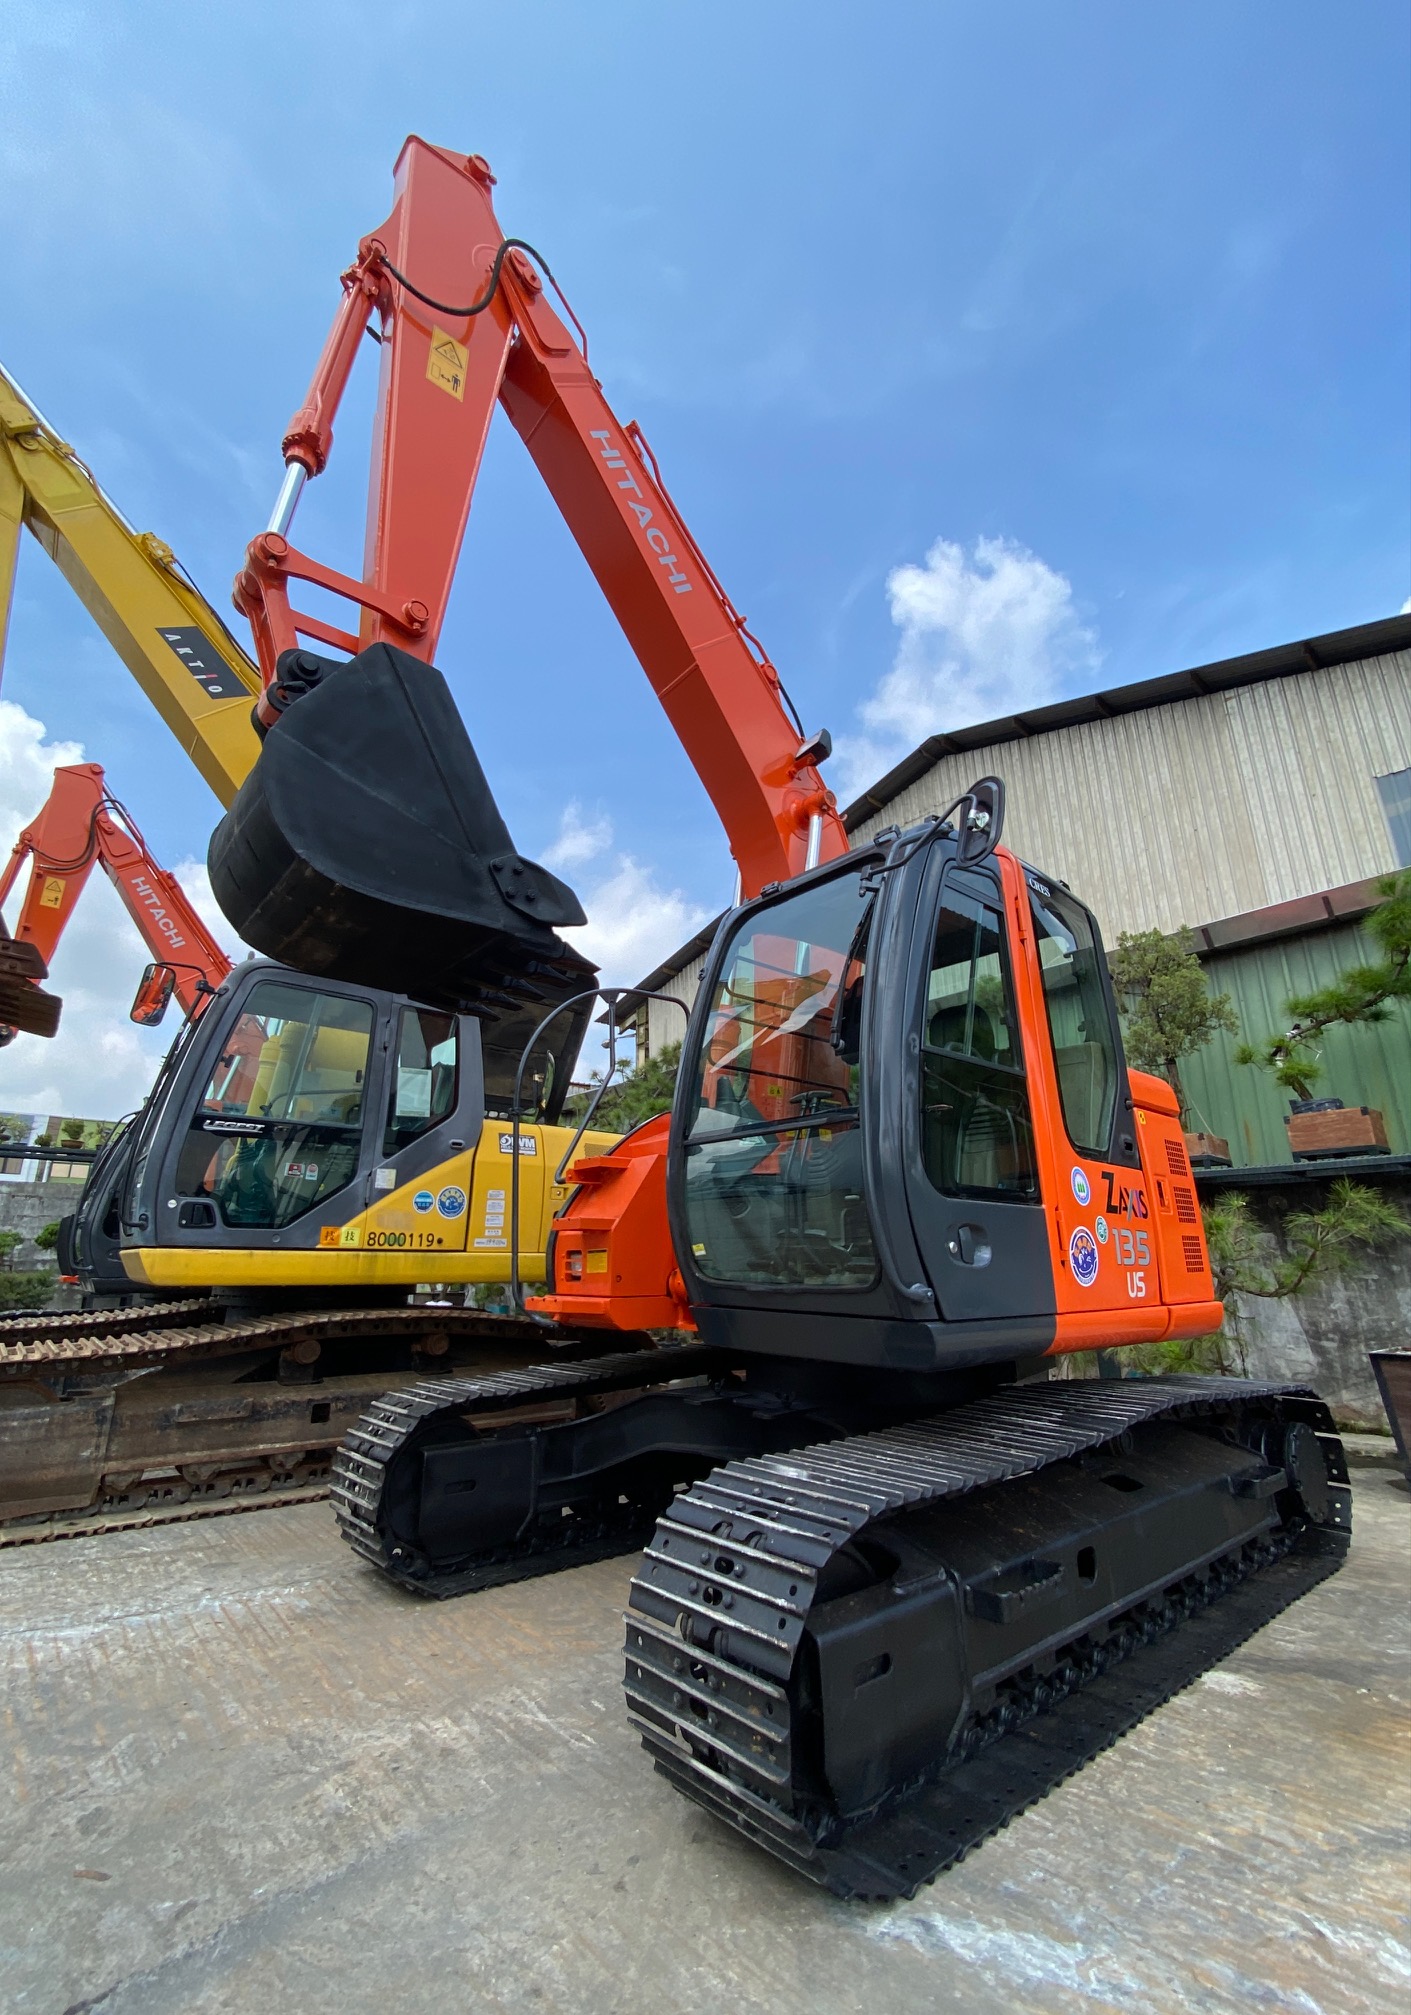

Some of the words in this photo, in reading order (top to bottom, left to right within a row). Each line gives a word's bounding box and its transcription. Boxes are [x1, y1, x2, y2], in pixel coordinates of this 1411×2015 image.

[590, 430, 692, 594] HITACHI
[165, 633, 223, 693] AKTIO
[1029, 878, 1050, 897] CRES
[131, 876, 186, 949] HITACHI
[1101, 1170, 1149, 1222] ZAXIS
[367, 1231, 435, 1247] 8000119
[1112, 1228, 1151, 1266] 135
[1126, 1271, 1146, 1298] US
